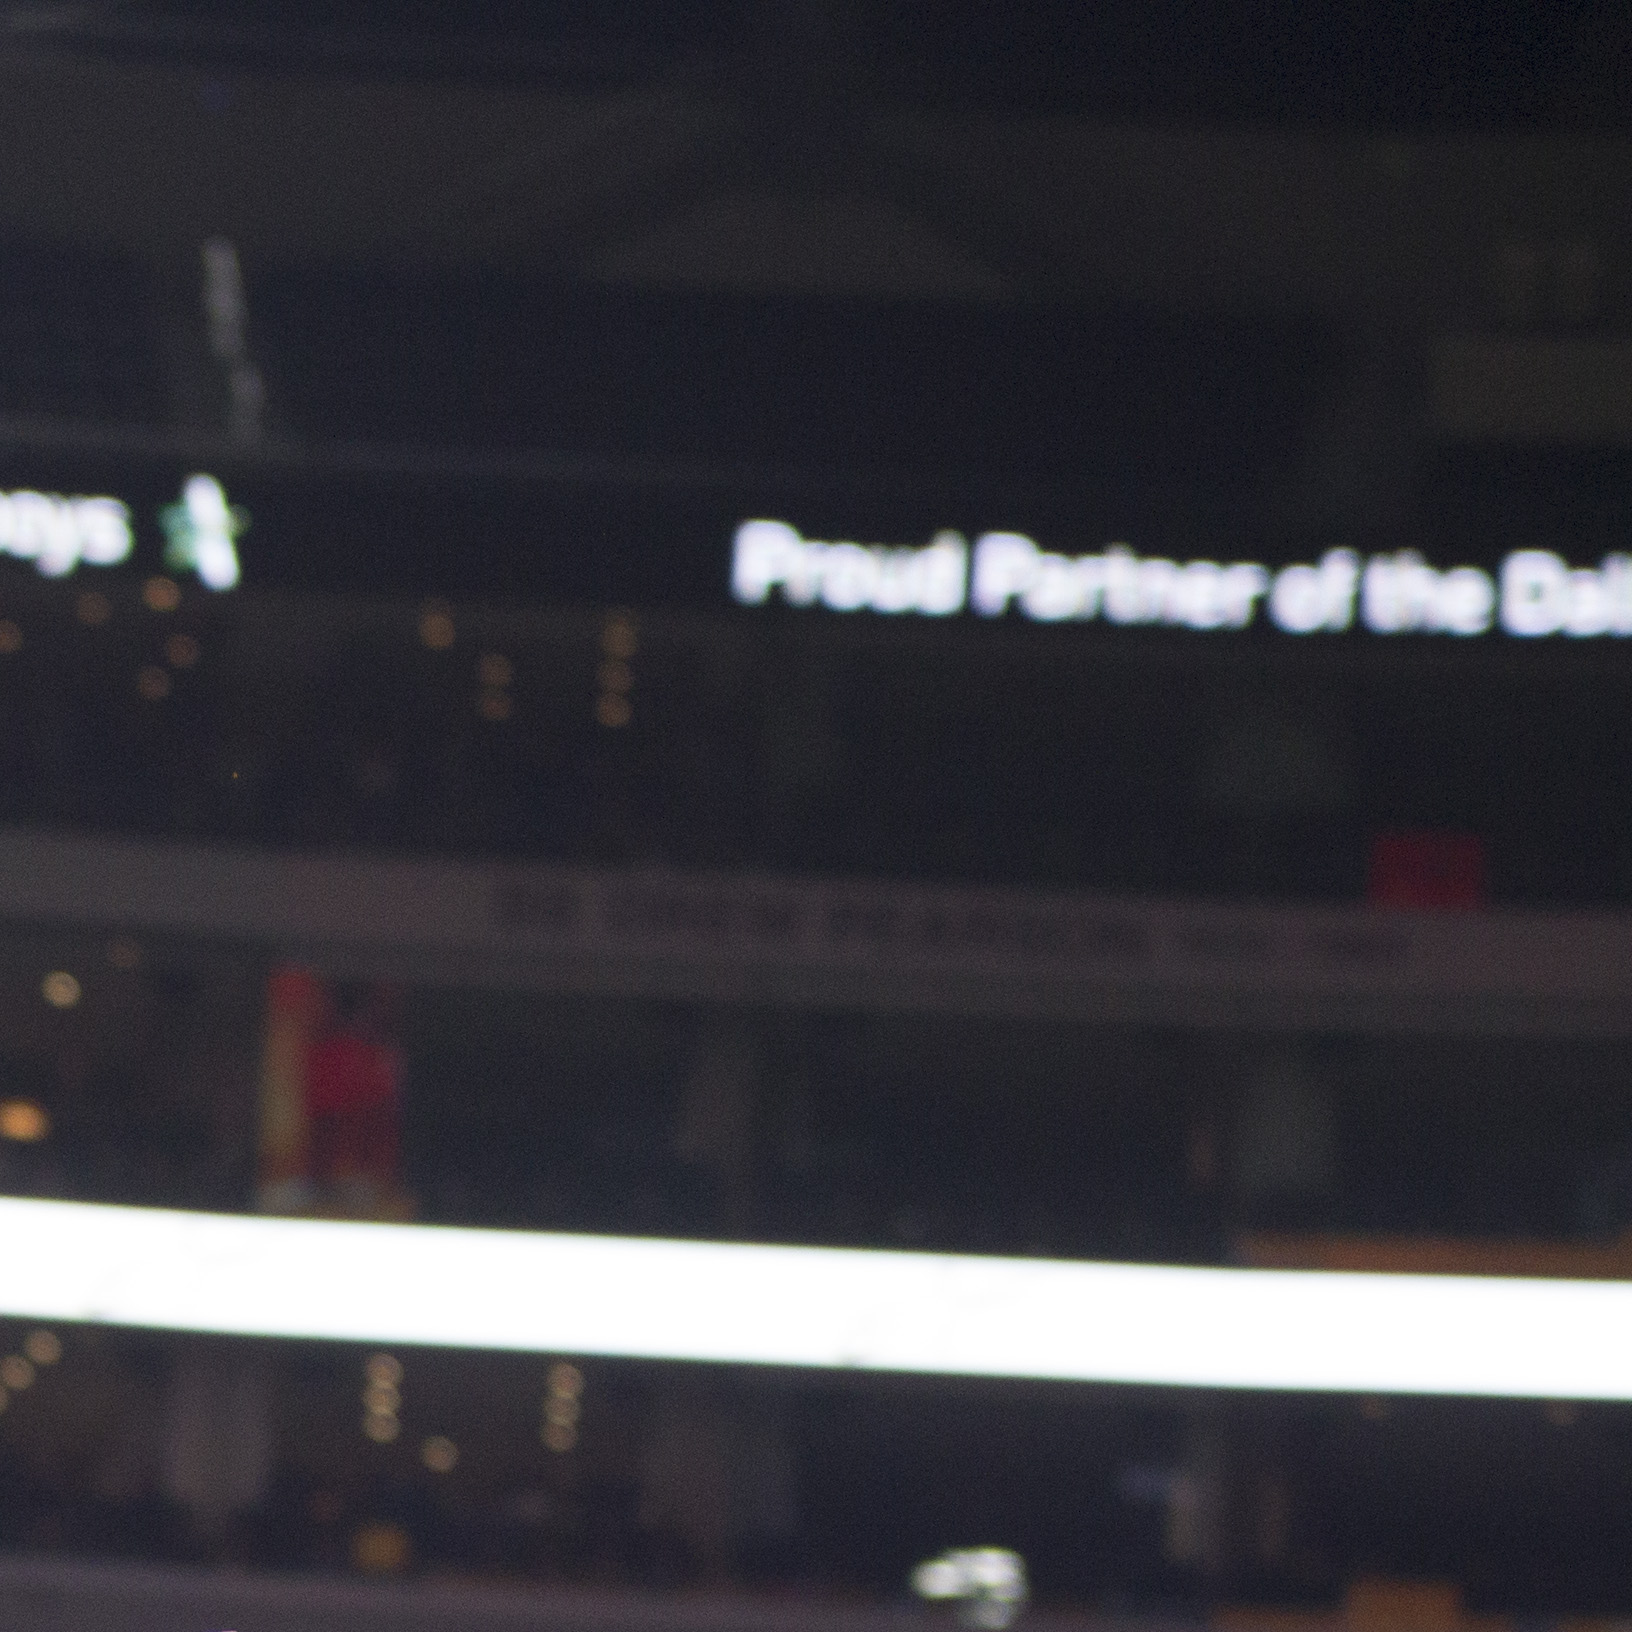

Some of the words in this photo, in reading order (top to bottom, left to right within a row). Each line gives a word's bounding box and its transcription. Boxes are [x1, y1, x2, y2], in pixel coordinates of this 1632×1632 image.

[732, 519, 969, 615] Proud
[971, 531, 1270, 629] Partner
[1270, 548, 1361, 633] of
[1362, 552, 1496, 636] the
